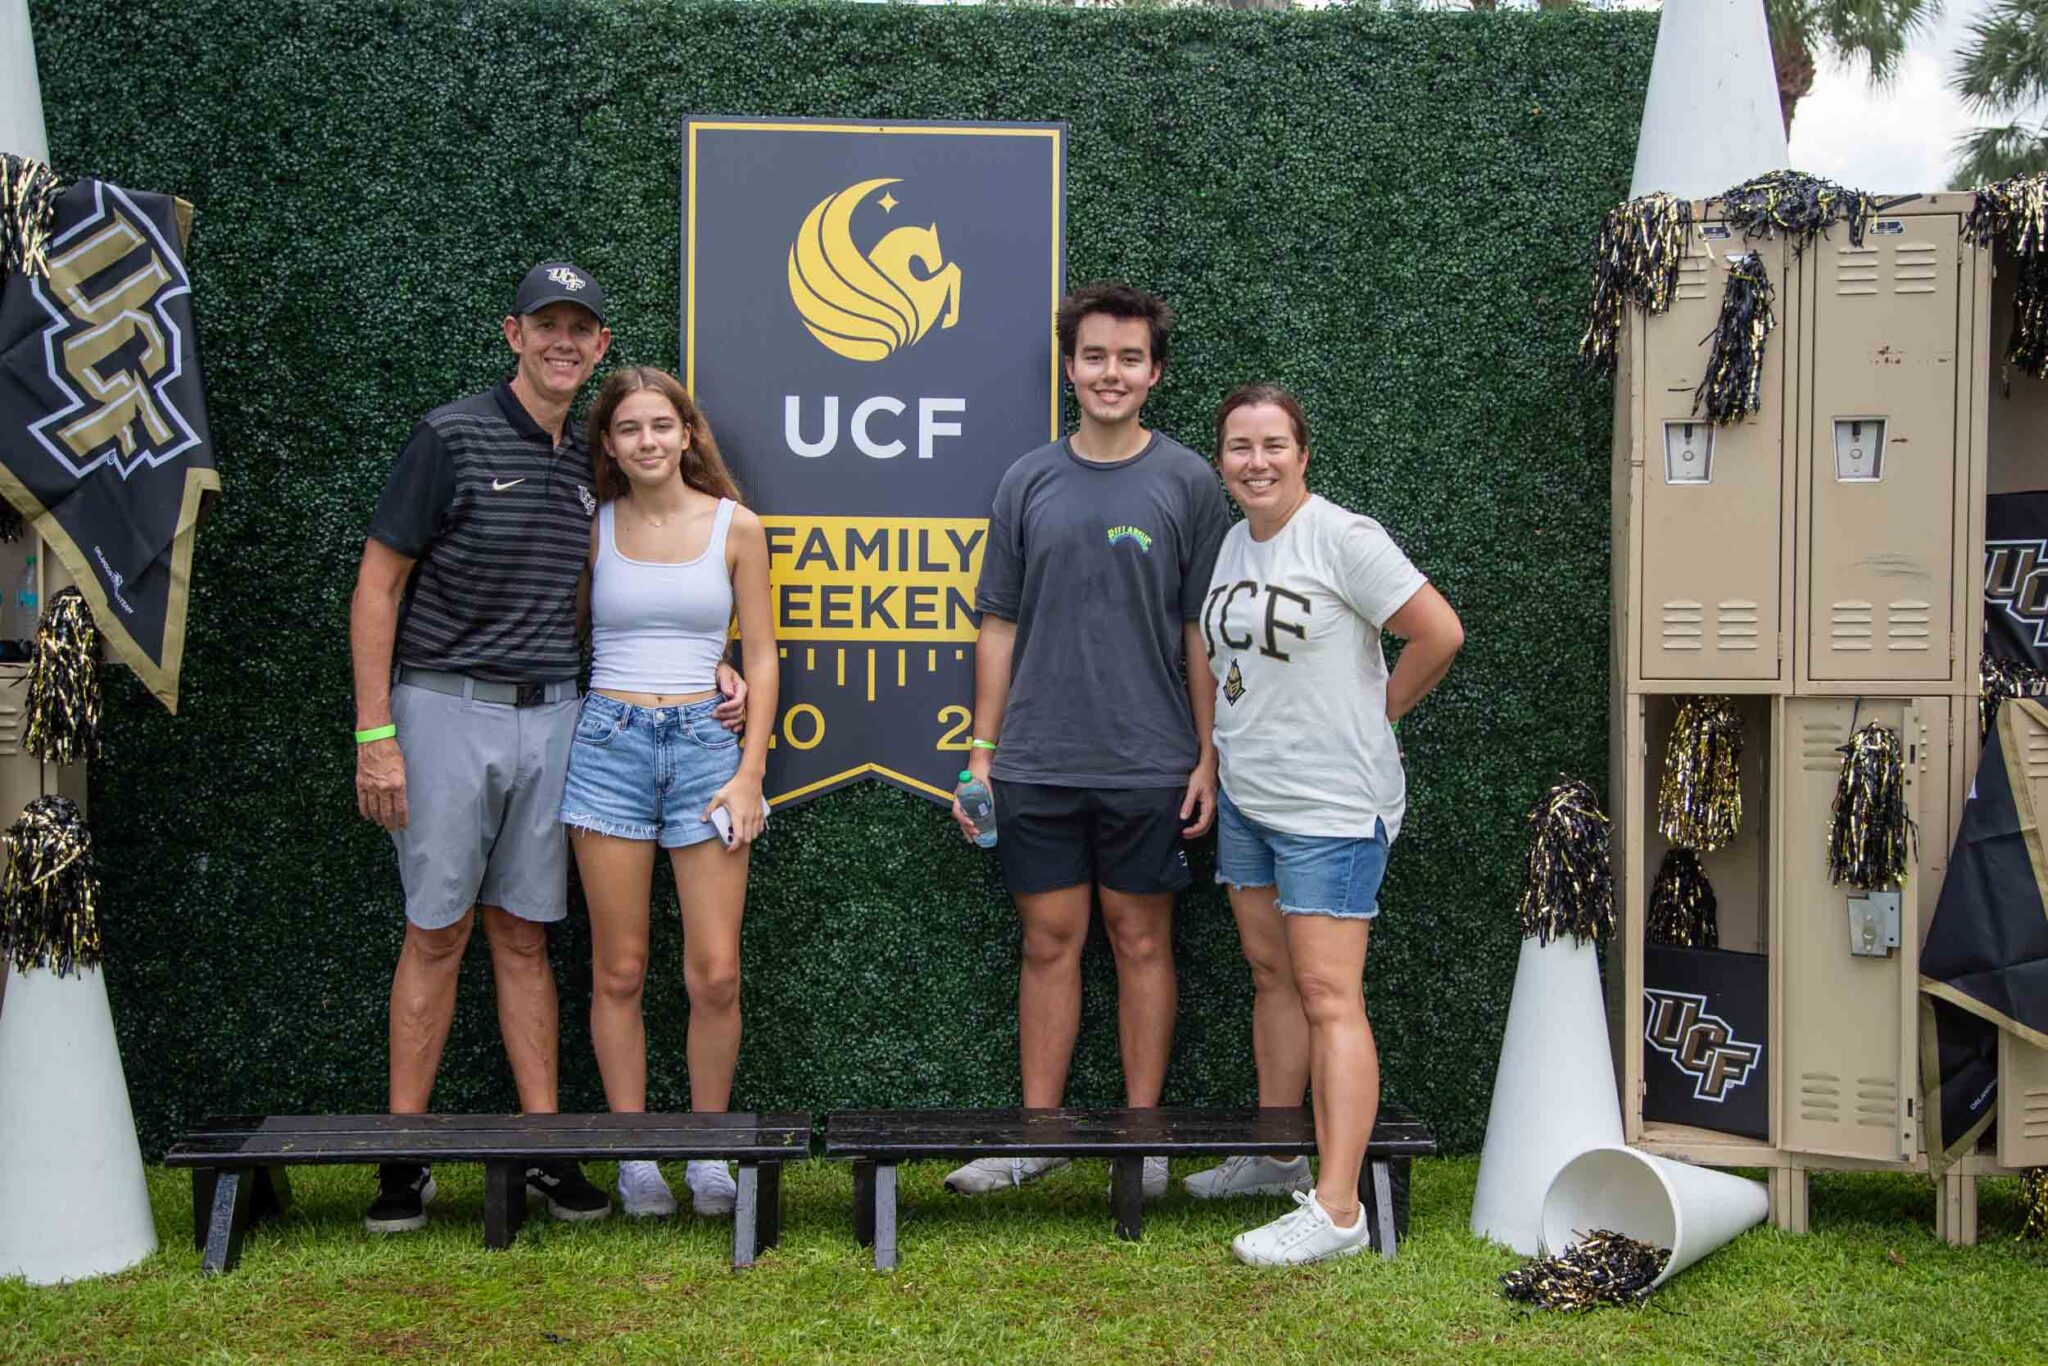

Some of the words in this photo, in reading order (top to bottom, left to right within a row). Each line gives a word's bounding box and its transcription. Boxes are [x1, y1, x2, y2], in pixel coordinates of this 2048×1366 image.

[546, 268, 586, 292] UCF
[42, 200, 180, 463] UCF
[785, 396, 966, 459] UCF
[765, 527, 985, 572] FAMILY
[769, 584, 982, 630] EEKEN
[1985, 545, 2048, 622] UC
[768, 703, 826, 750] 0
[936, 704, 973, 751] 2
[1649, 994, 1757, 1097] UCF
